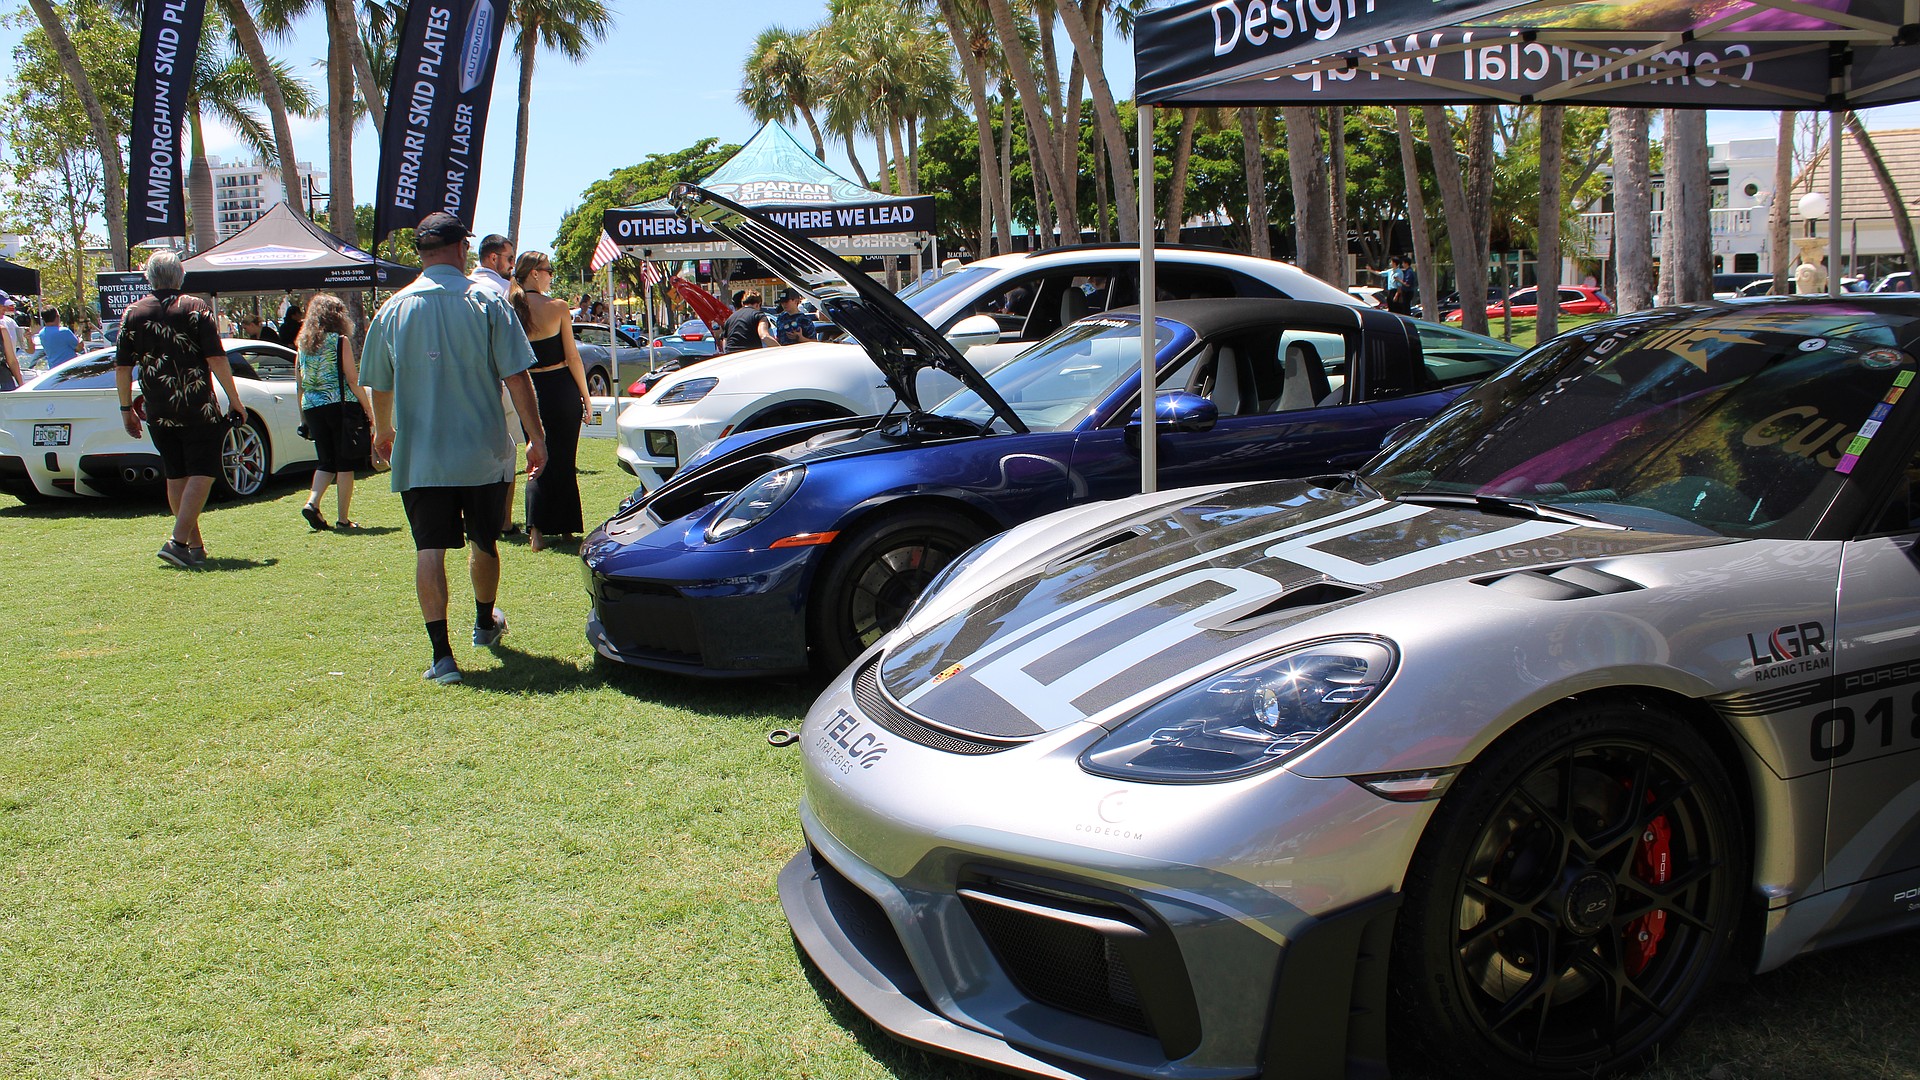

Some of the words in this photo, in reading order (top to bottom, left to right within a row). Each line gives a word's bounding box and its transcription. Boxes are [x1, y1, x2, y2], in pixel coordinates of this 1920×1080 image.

[155, 21, 180, 77] SKID
[422, 5, 451, 80] PLATES
[466, 8, 487, 79] AUTOMODS
[411, 80, 435, 129] SKID
[453, 102, 474, 156] LASER
[146, 78, 175, 225] LAMBORGHINI
[395, 122, 425, 211] FERRARI
[443, 169, 467, 217] ADAR
[741, 182, 829, 194] SPARTAN
[763, 190, 830, 200] Solutions
[618, 218, 686, 237] OTHERS
[769, 210, 832, 230] WHERE
[836, 208, 866, 227] WE
[869, 205, 915, 225] LEAD
[224, 254, 308, 262] AUTOMODS
[324, 275, 371, 283] AUTOMODSFL.COM
[107, 294, 128, 304] SKID
[1746, 621, 1827, 667] LGR
[1755, 662, 1797, 682] RACING
[1798, 657, 1831, 673] TEAM
[815, 737, 854, 776] STRATEGIES
[1075, 822, 1144, 841] CODECOM
[1585, 899, 1607, 914] RS
